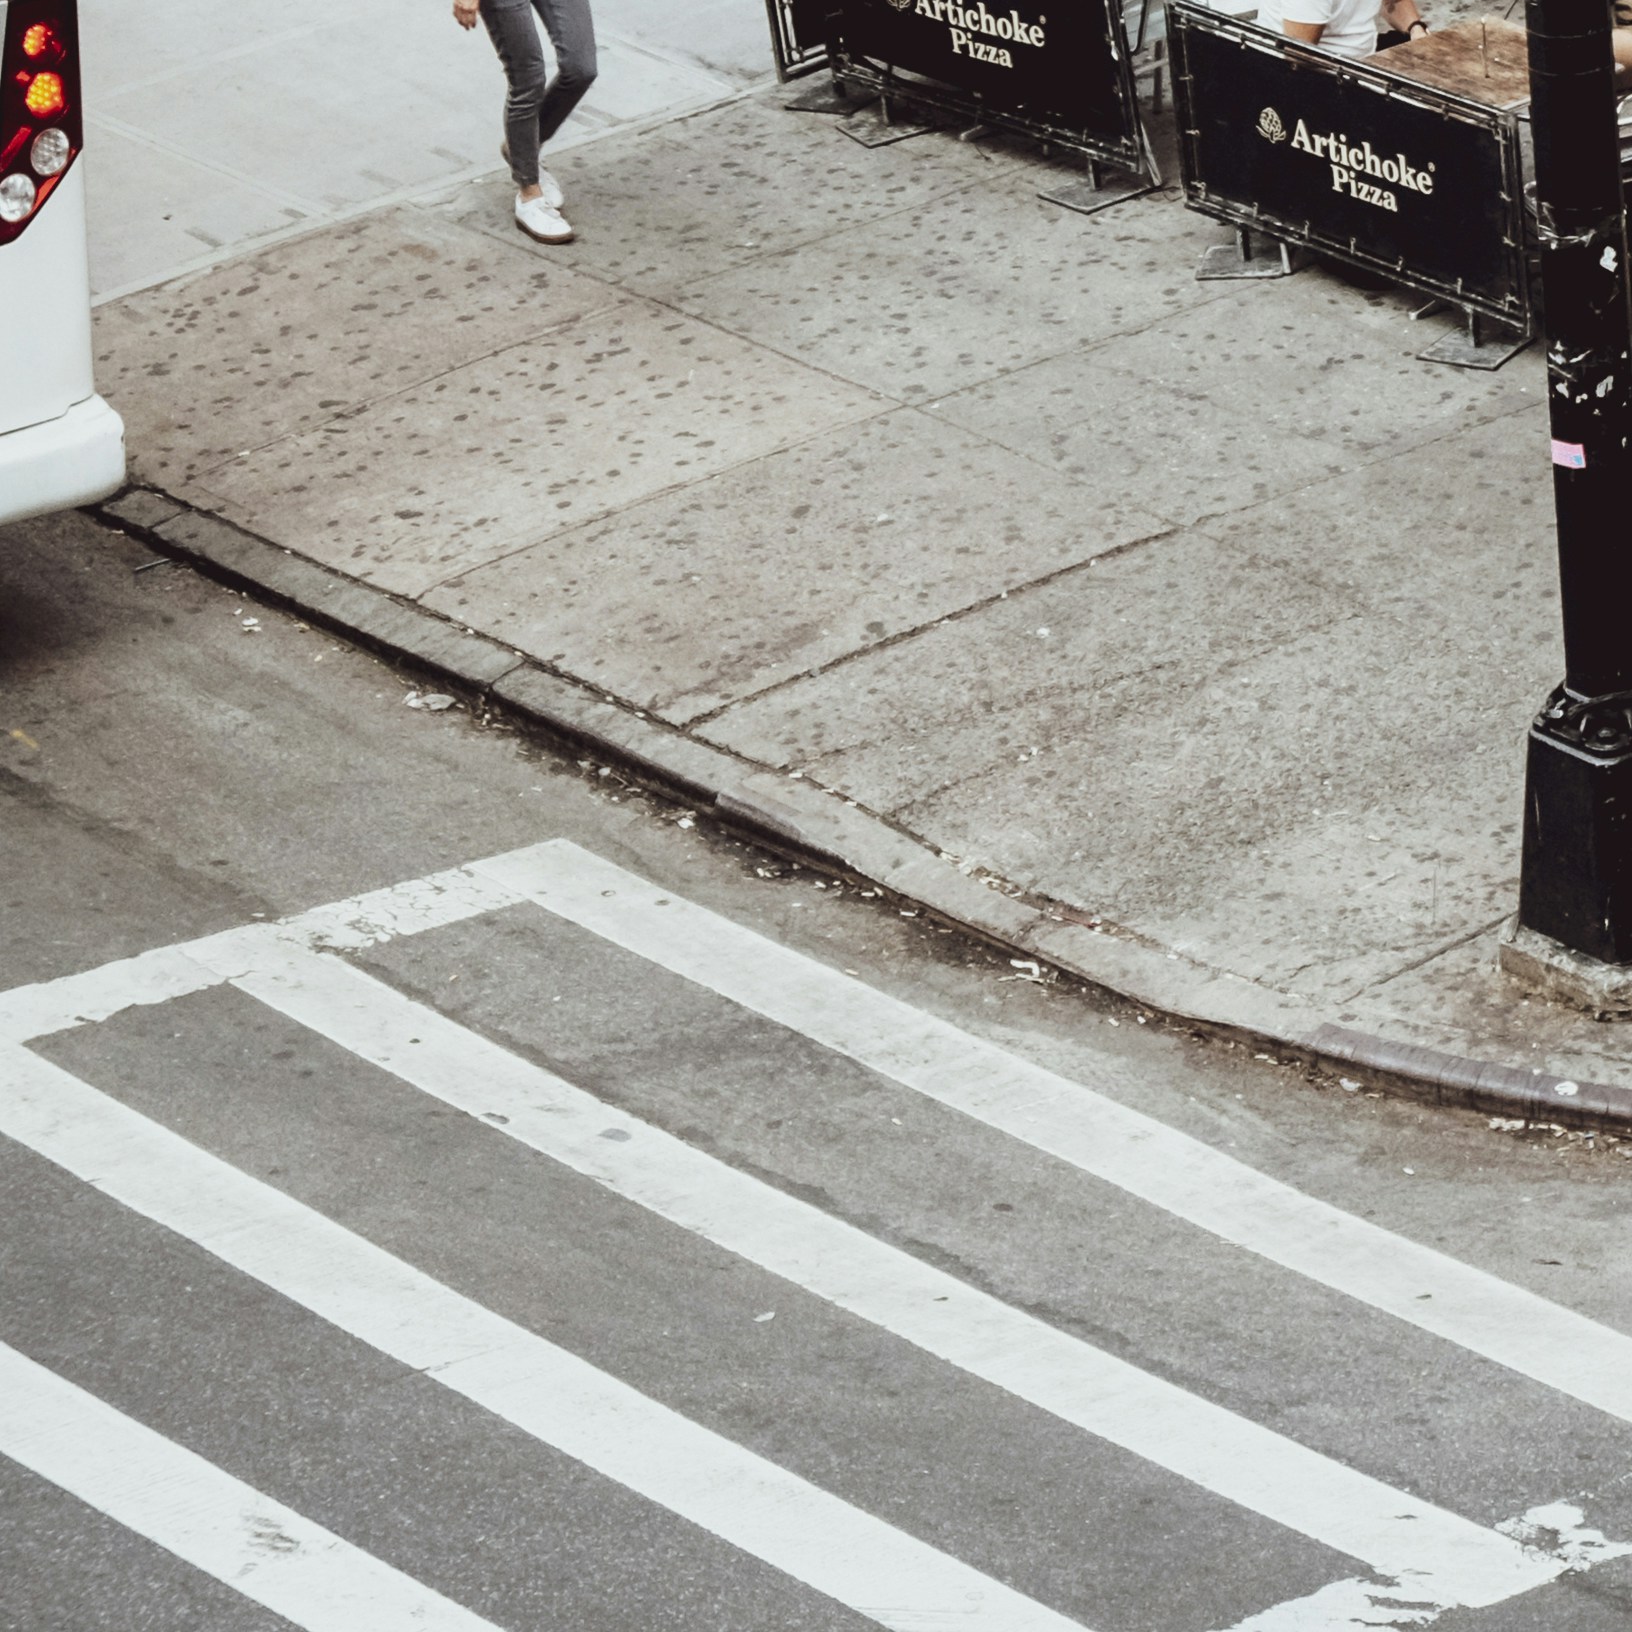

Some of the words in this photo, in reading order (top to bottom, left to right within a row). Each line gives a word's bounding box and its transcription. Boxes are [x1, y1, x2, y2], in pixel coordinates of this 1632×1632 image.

[949, 27, 1013, 68] Pizza
[1290, 118, 1435, 196] Artichoke
[1330, 163, 1398, 212] Pizza
